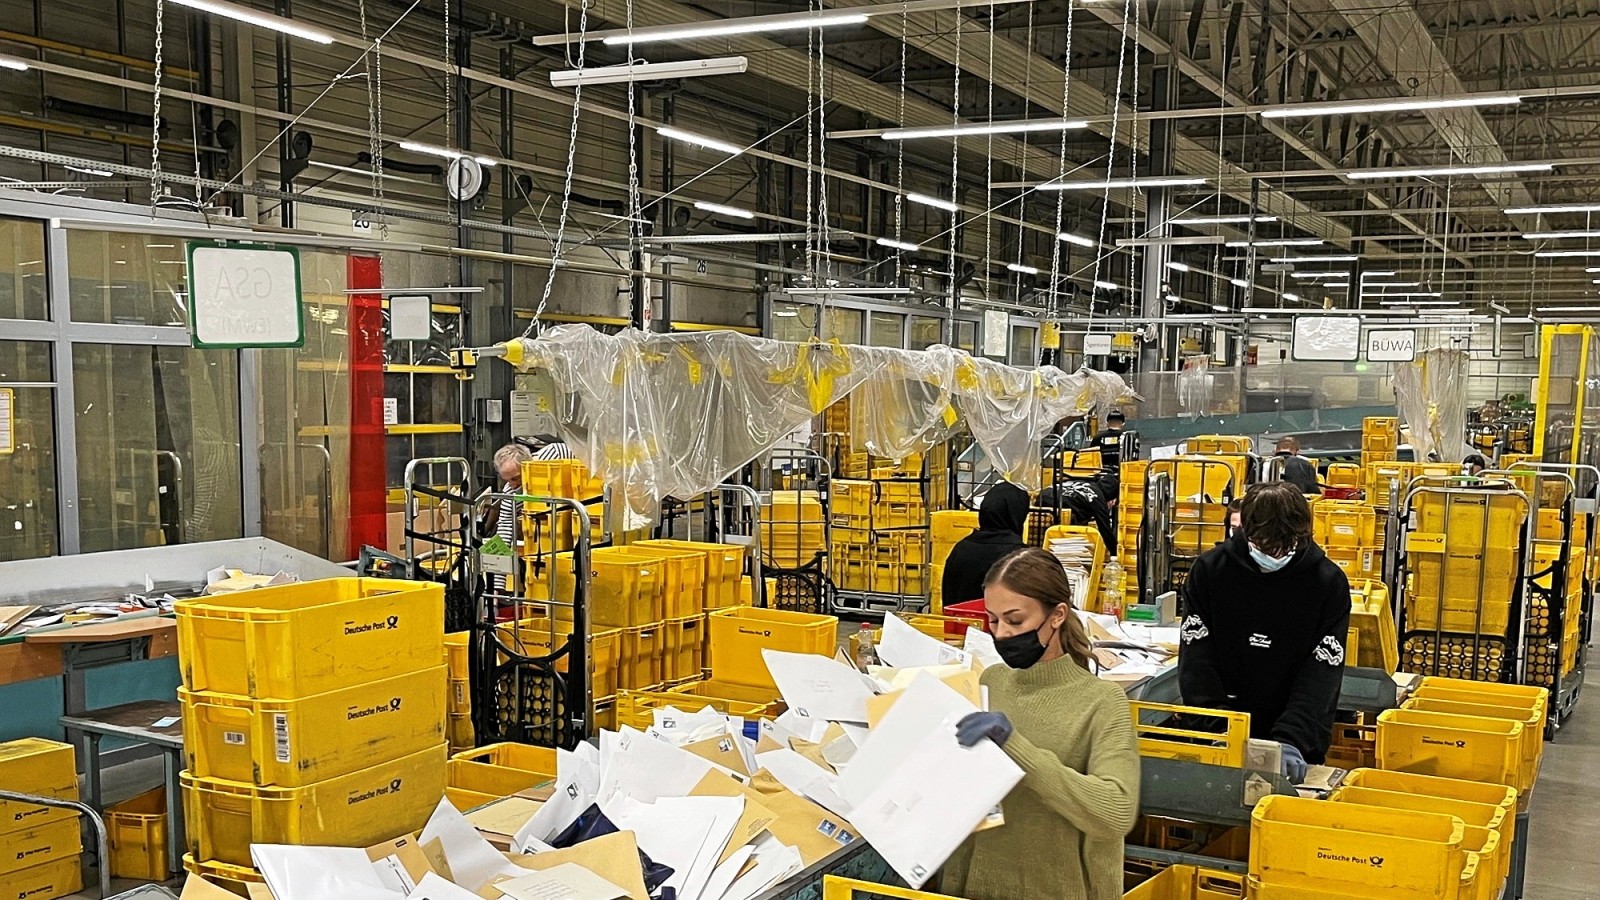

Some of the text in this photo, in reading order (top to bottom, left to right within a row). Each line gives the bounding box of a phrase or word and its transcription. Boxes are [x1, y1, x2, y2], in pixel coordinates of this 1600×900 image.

[1372, 338, 1413, 351] BÜWA
[344, 621, 386, 635] Deutsche Post
[347, 707, 375, 720] Deutsche
[376, 704, 388, 713] Post
[347, 790, 375, 805] Deutsche
[376, 786, 389, 796] Post
[1317, 851, 1367, 864] Deutsche Post
